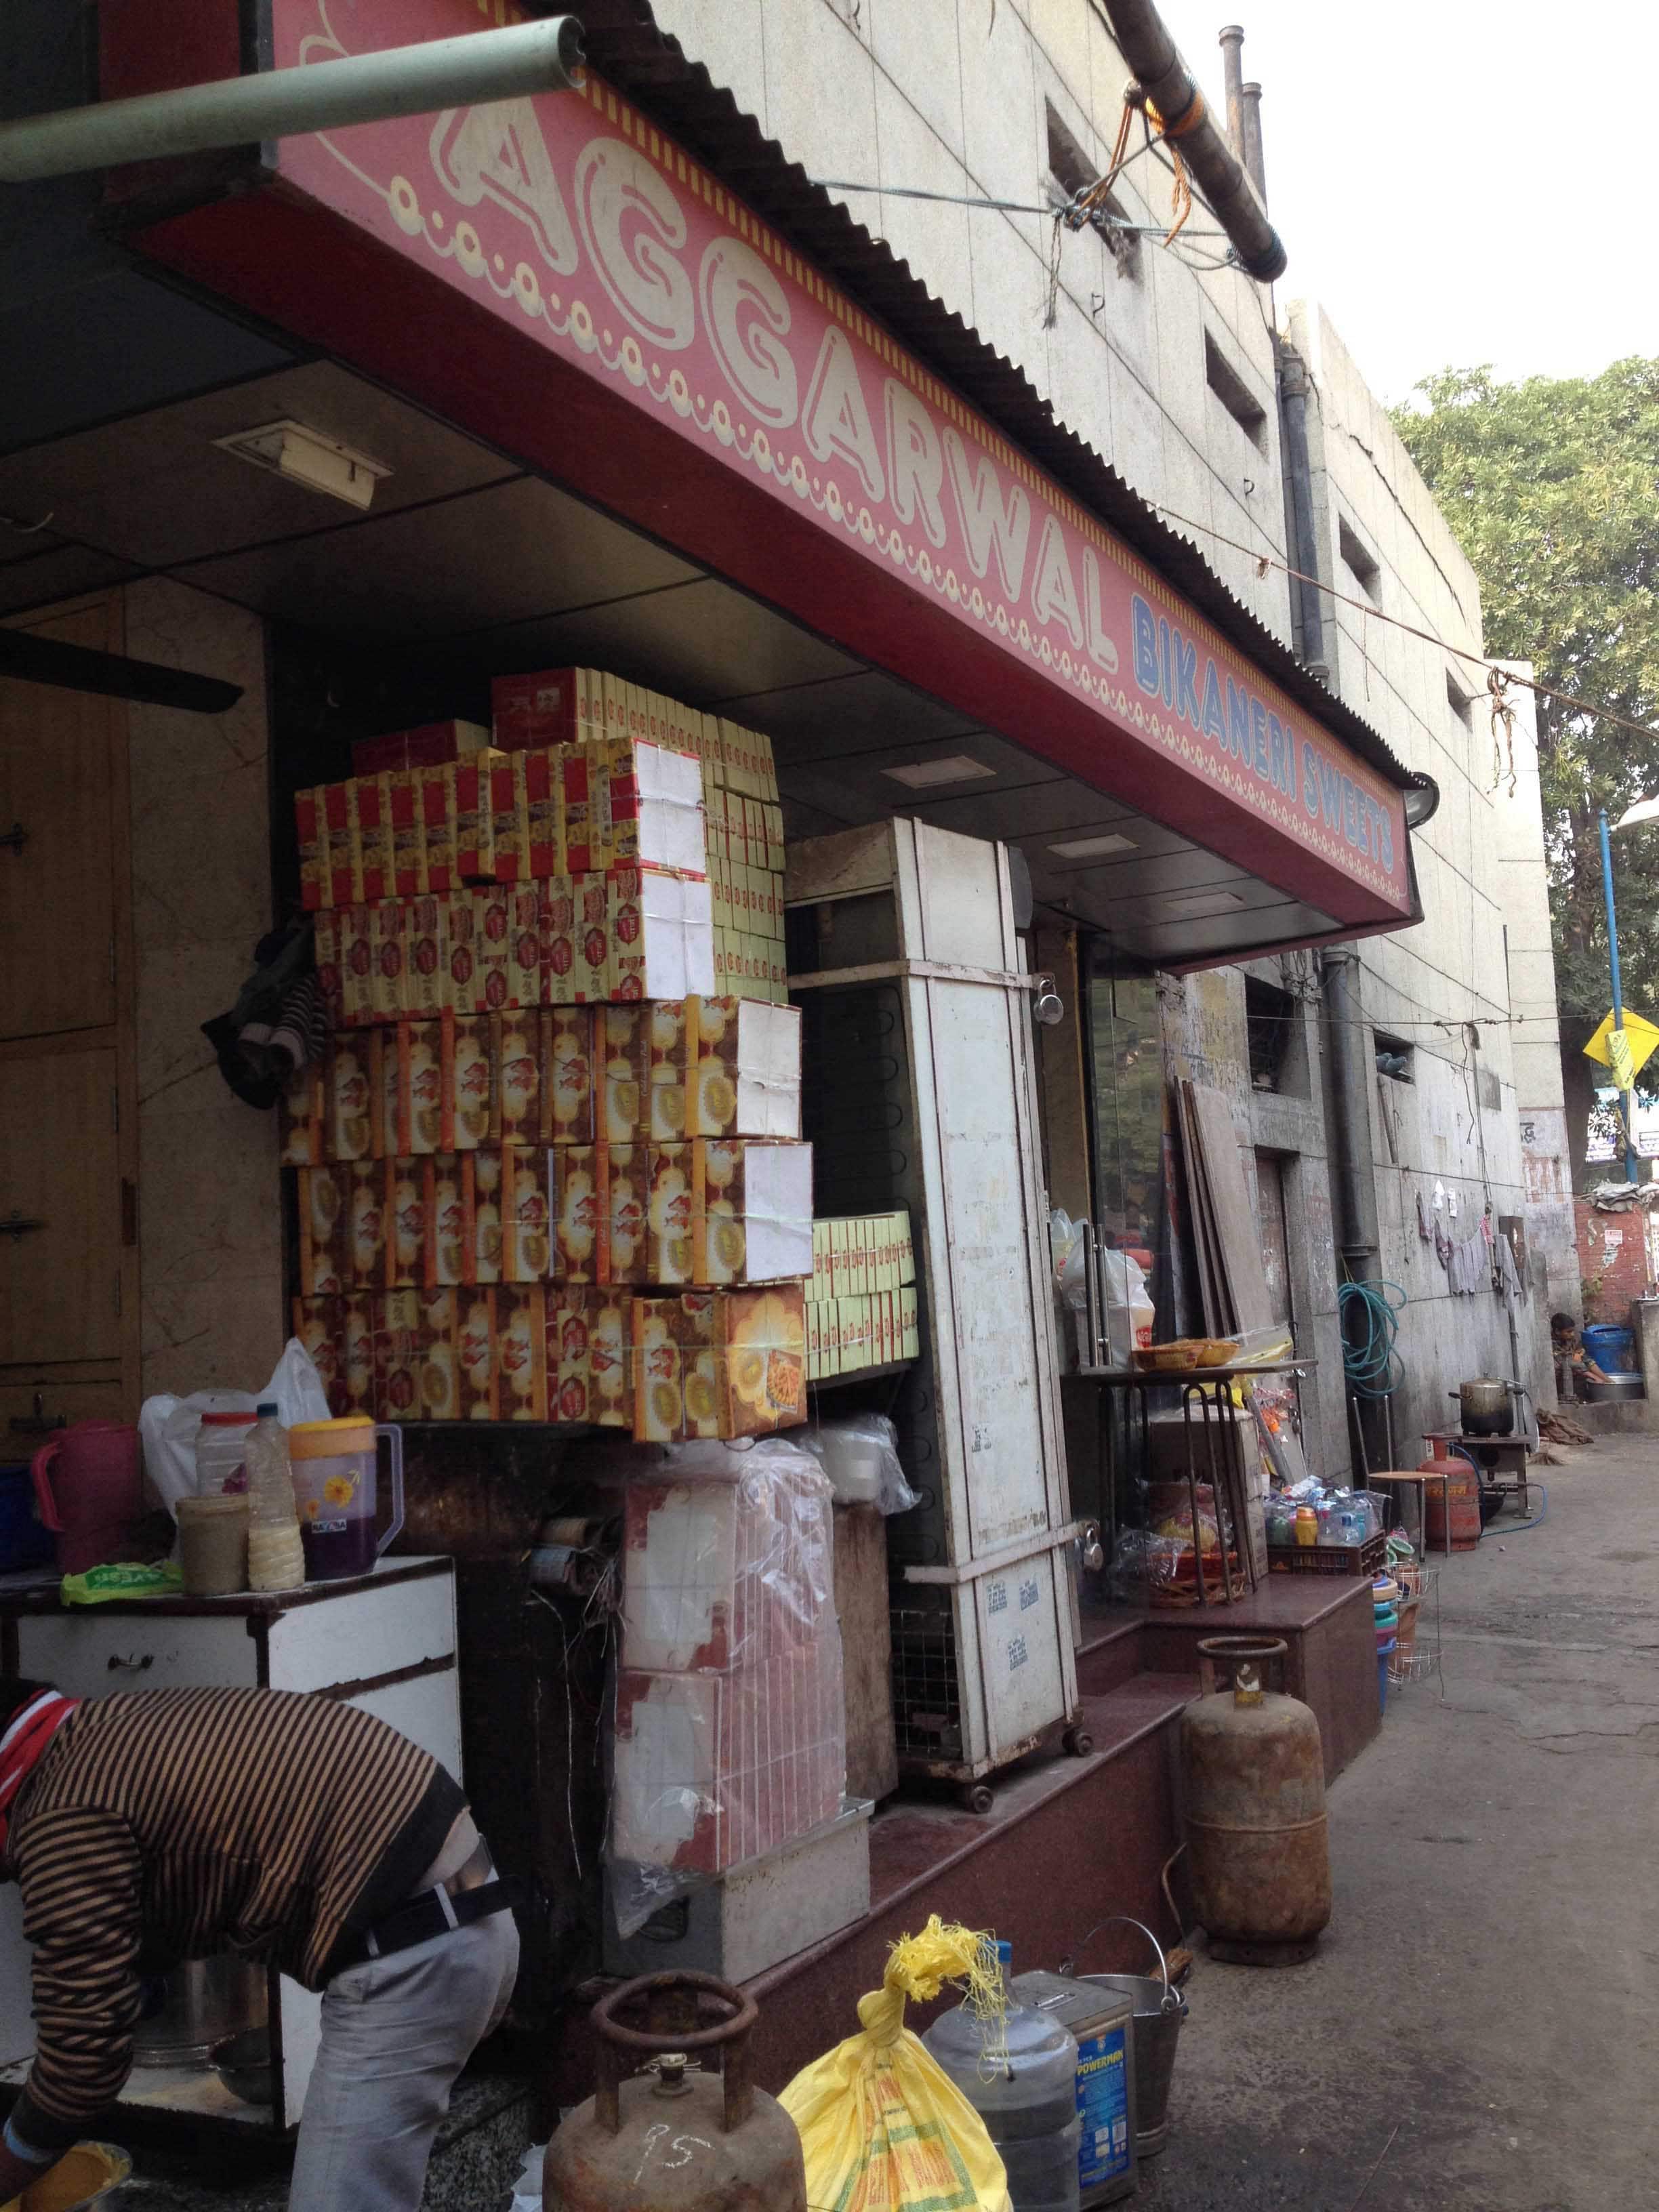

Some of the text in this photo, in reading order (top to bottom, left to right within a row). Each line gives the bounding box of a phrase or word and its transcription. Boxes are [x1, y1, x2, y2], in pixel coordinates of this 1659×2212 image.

[429, 94, 1395, 874] AGGARWAL BIKANERI SWEETS
